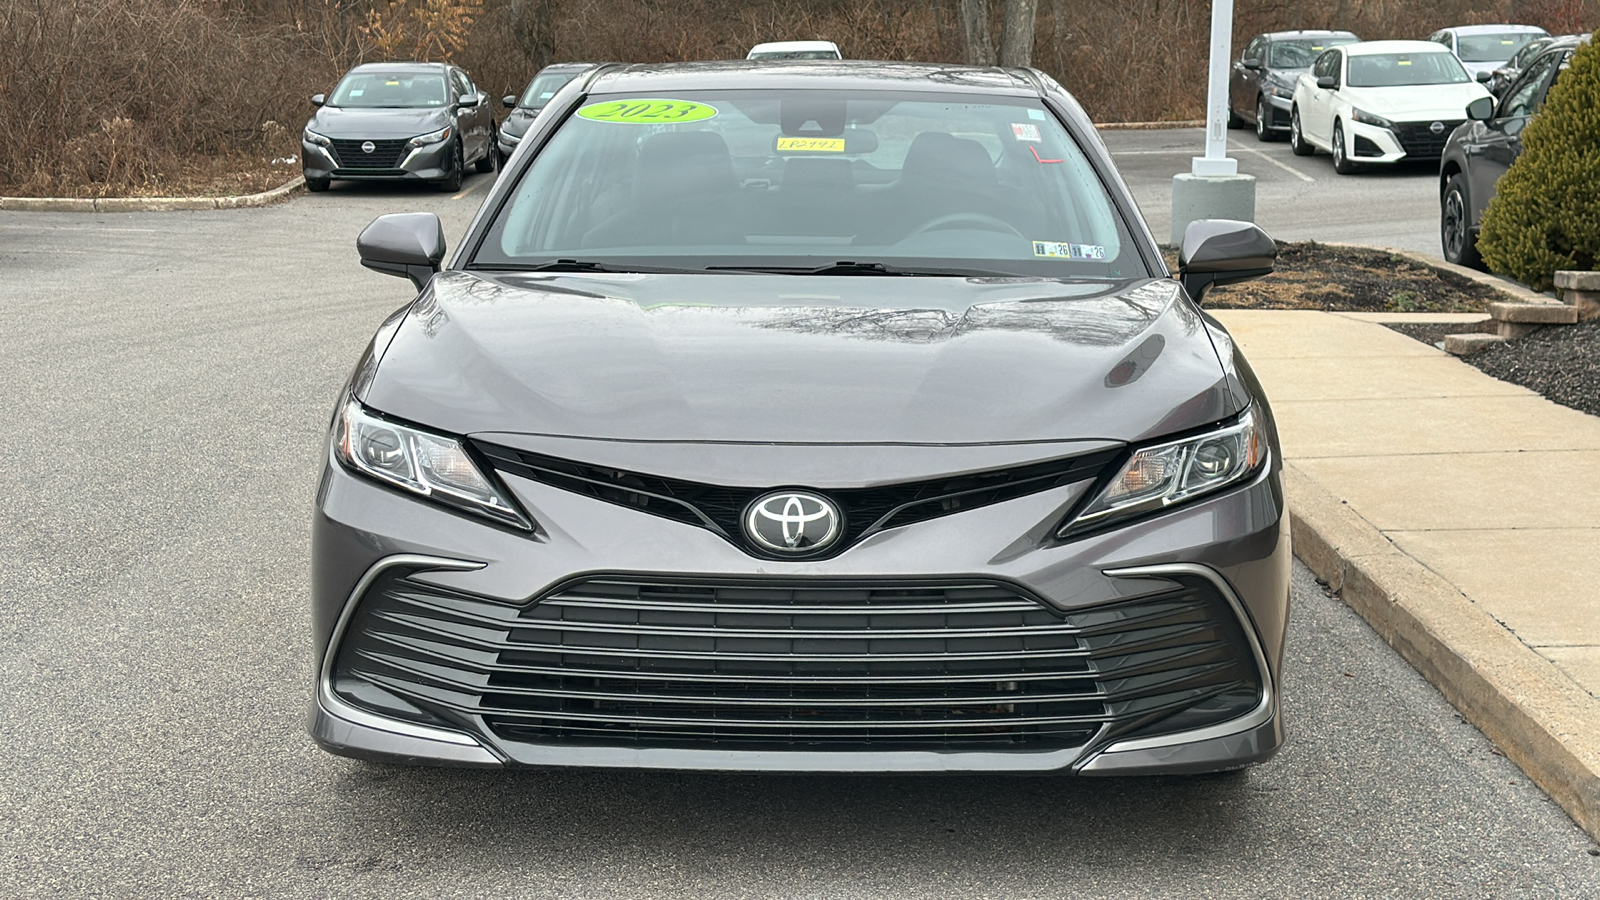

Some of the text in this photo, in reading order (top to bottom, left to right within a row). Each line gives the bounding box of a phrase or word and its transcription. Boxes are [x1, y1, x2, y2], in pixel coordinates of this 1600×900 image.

[594, 103, 698, 119] 2023
[1058, 244, 1068, 256] 26
[1094, 246, 1105, 258] 26
